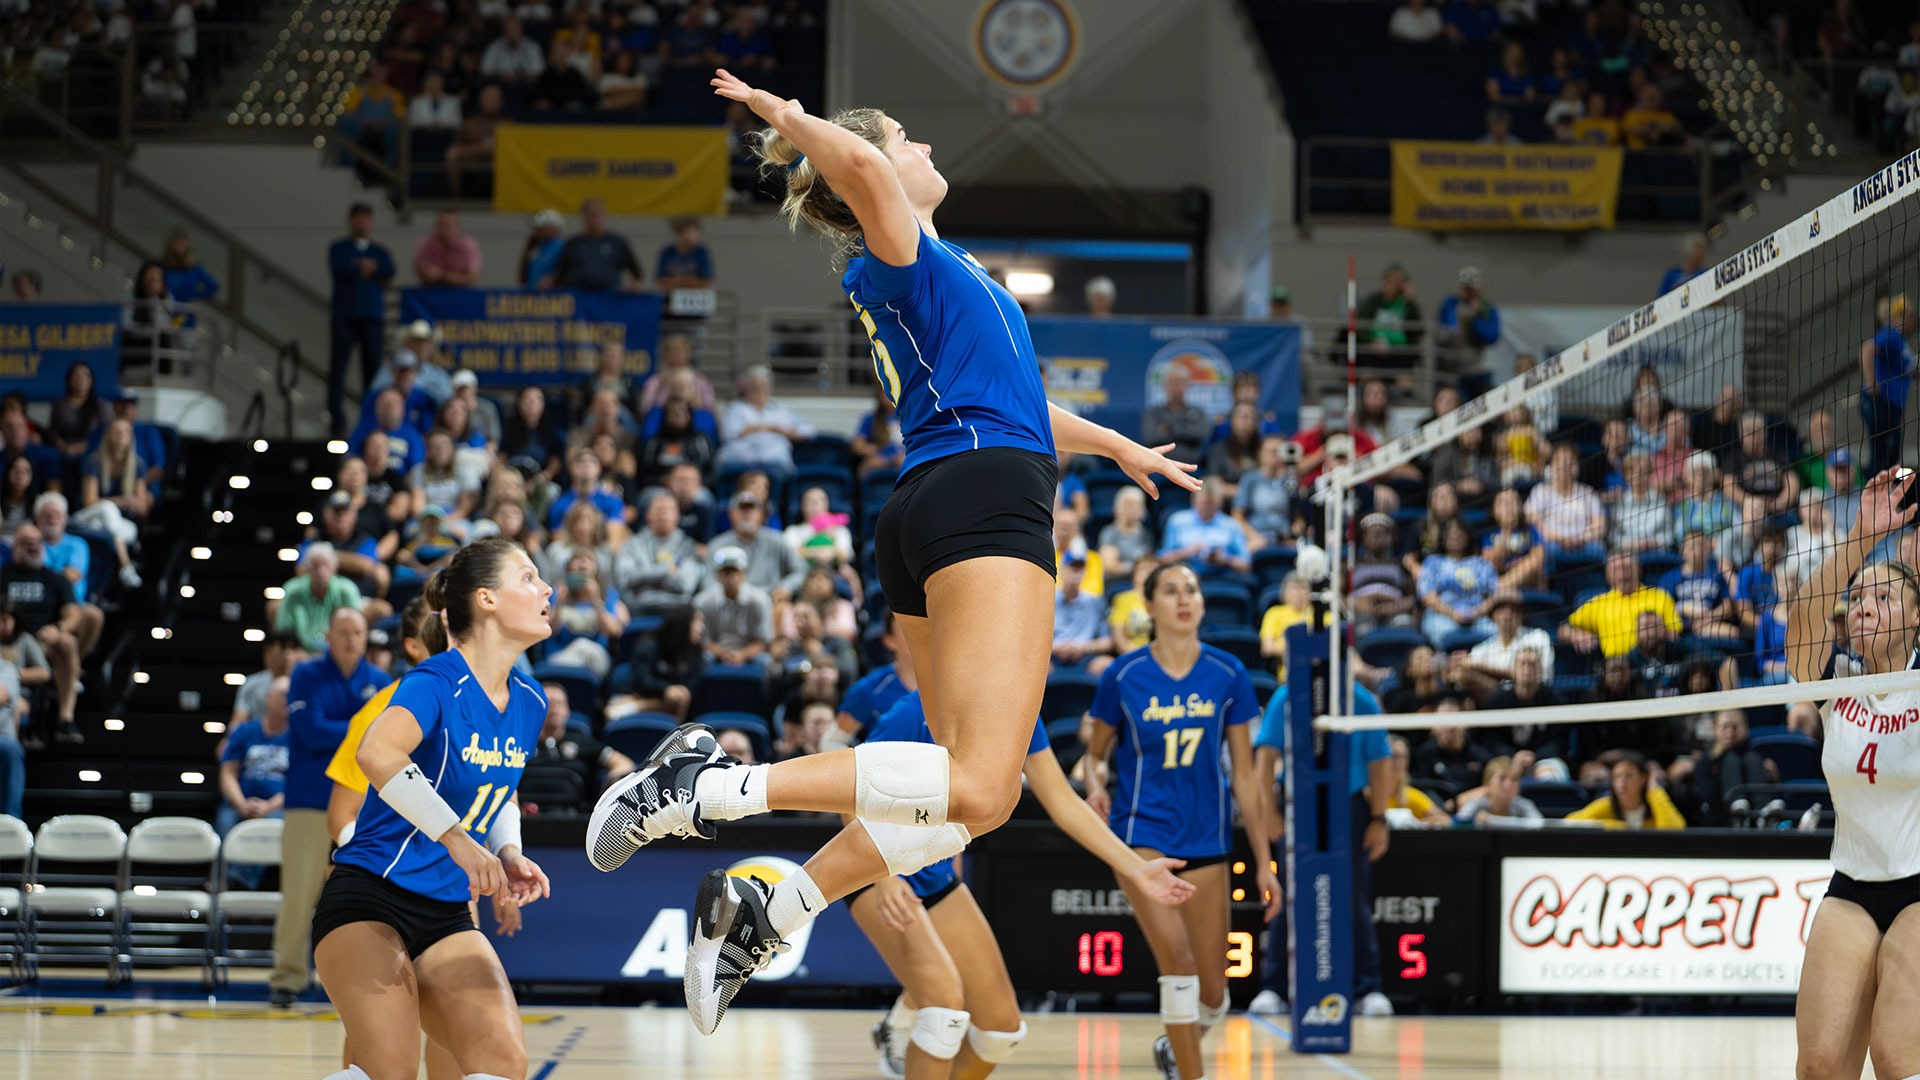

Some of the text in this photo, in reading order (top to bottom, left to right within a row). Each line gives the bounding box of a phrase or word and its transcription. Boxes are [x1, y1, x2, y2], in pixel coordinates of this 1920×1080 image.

[1853, 150, 1920, 214] ANGELO STA
[1714, 257, 1746, 291] ANGELO
[1142, 693, 1216, 725] Angelo State
[462, 732, 503, 772] Angelo
[1162, 727, 1205, 769] 17
[1856, 742, 1878, 784] 4
[460, 783, 509, 834] 11
[1509, 874, 1779, 949] CARPET
[1078, 931, 1124, 976] 10
[1225, 931, 1253, 978] 3
[1398, 933, 1427, 979] 5
[1540, 963, 1786, 981] FLOOR CARE AIR DUCTS
